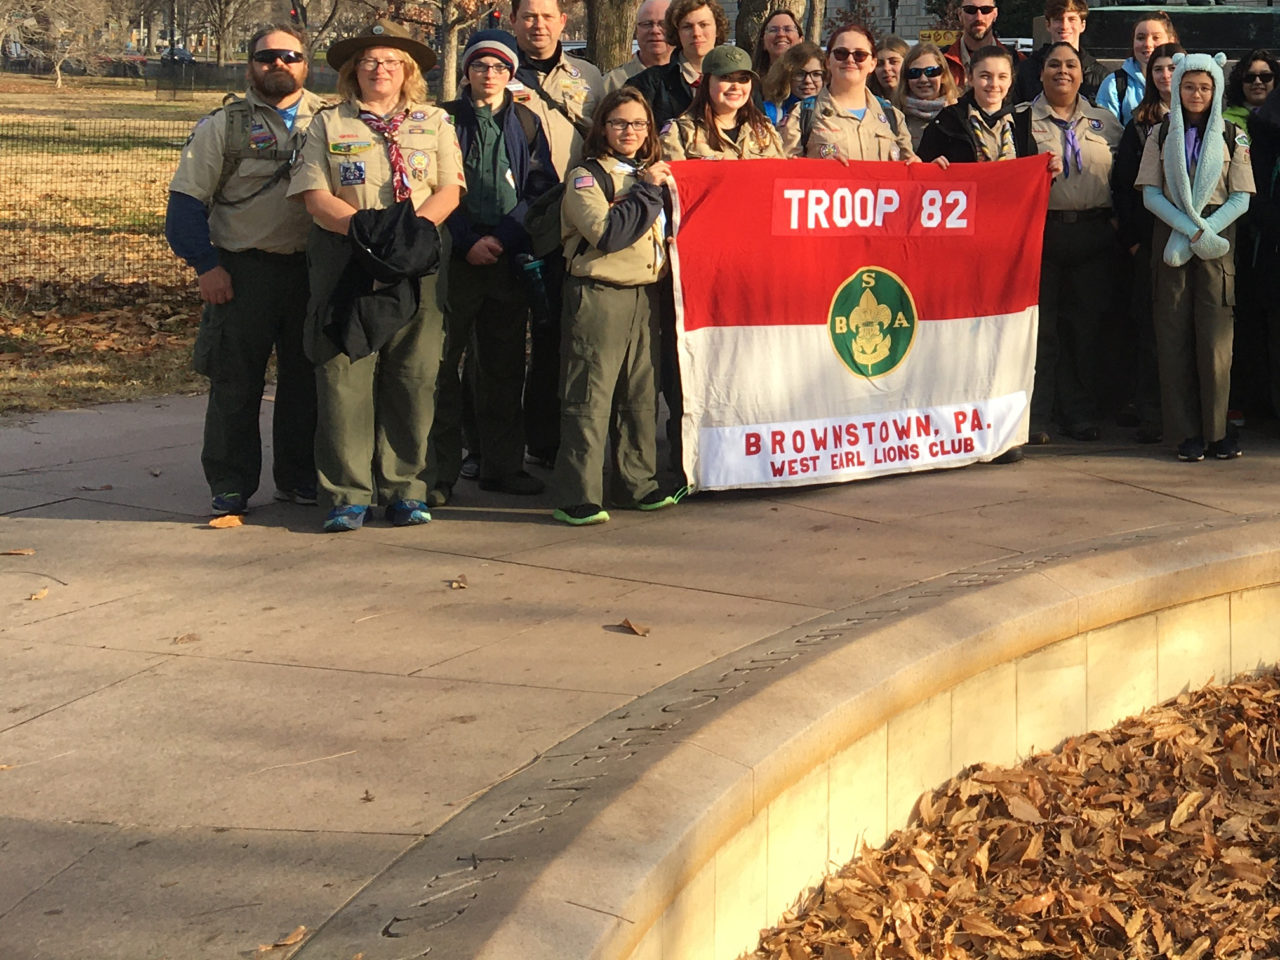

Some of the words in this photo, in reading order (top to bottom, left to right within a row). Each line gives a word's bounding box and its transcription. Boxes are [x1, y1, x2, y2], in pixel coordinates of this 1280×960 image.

[784, 188, 900, 229] TROOP
[920, 189, 968, 228] 82
[745, 414, 940, 456] BROWNSTOWN,
[954, 408, 993, 434] PA.
[769, 455, 821, 478] WEST
[830, 450, 866, 471] EARL
[873, 443, 920, 465] LIONS
[928, 436, 976, 458] CLUB
